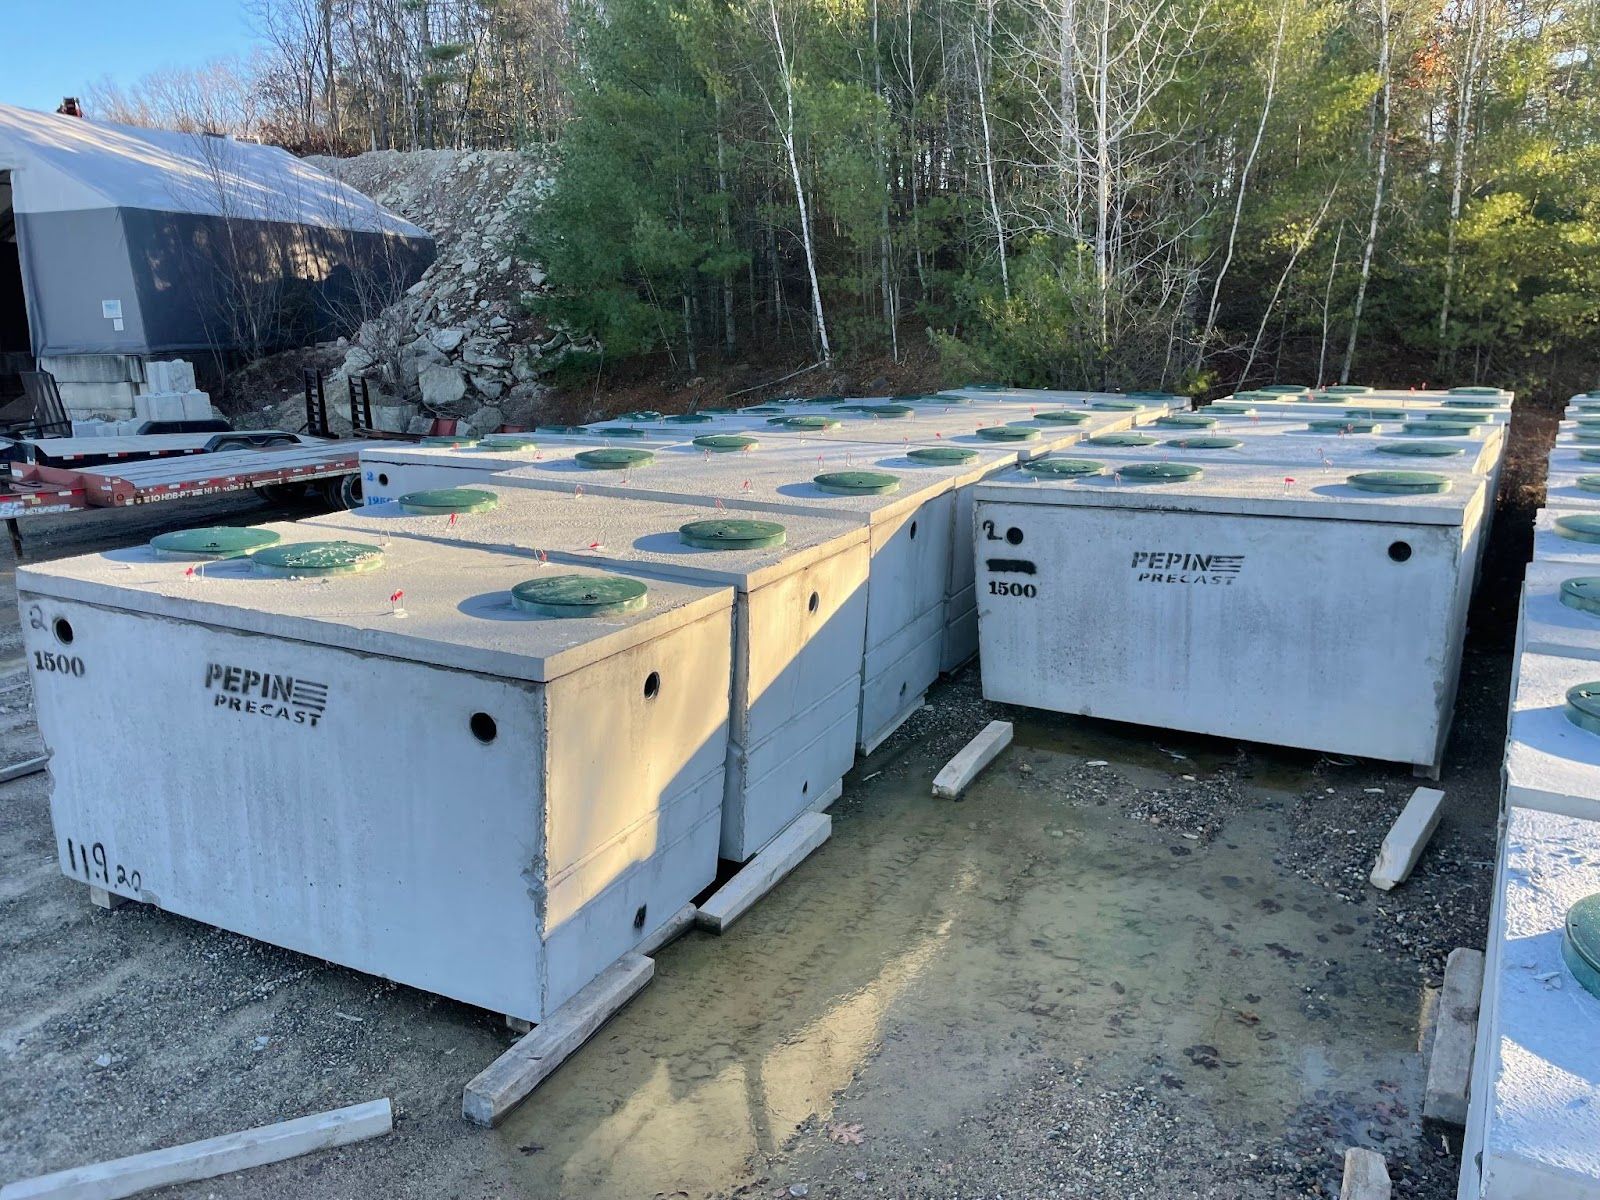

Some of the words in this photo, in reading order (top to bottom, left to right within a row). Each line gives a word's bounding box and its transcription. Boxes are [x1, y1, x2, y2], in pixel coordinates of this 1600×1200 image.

[366, 472, 374, 481] 2
[982, 519, 1003, 541] 2
[1131, 551, 1213, 571] PEPIN
[988, 580, 1037, 599] 1500
[1138, 572, 1236, 585] PRECAST
[29, 604, 48, 632] 2
[33, 650, 85, 678] 1500
[204, 662, 294, 703] PEPIN
[214, 693, 322, 728] PRECAST
